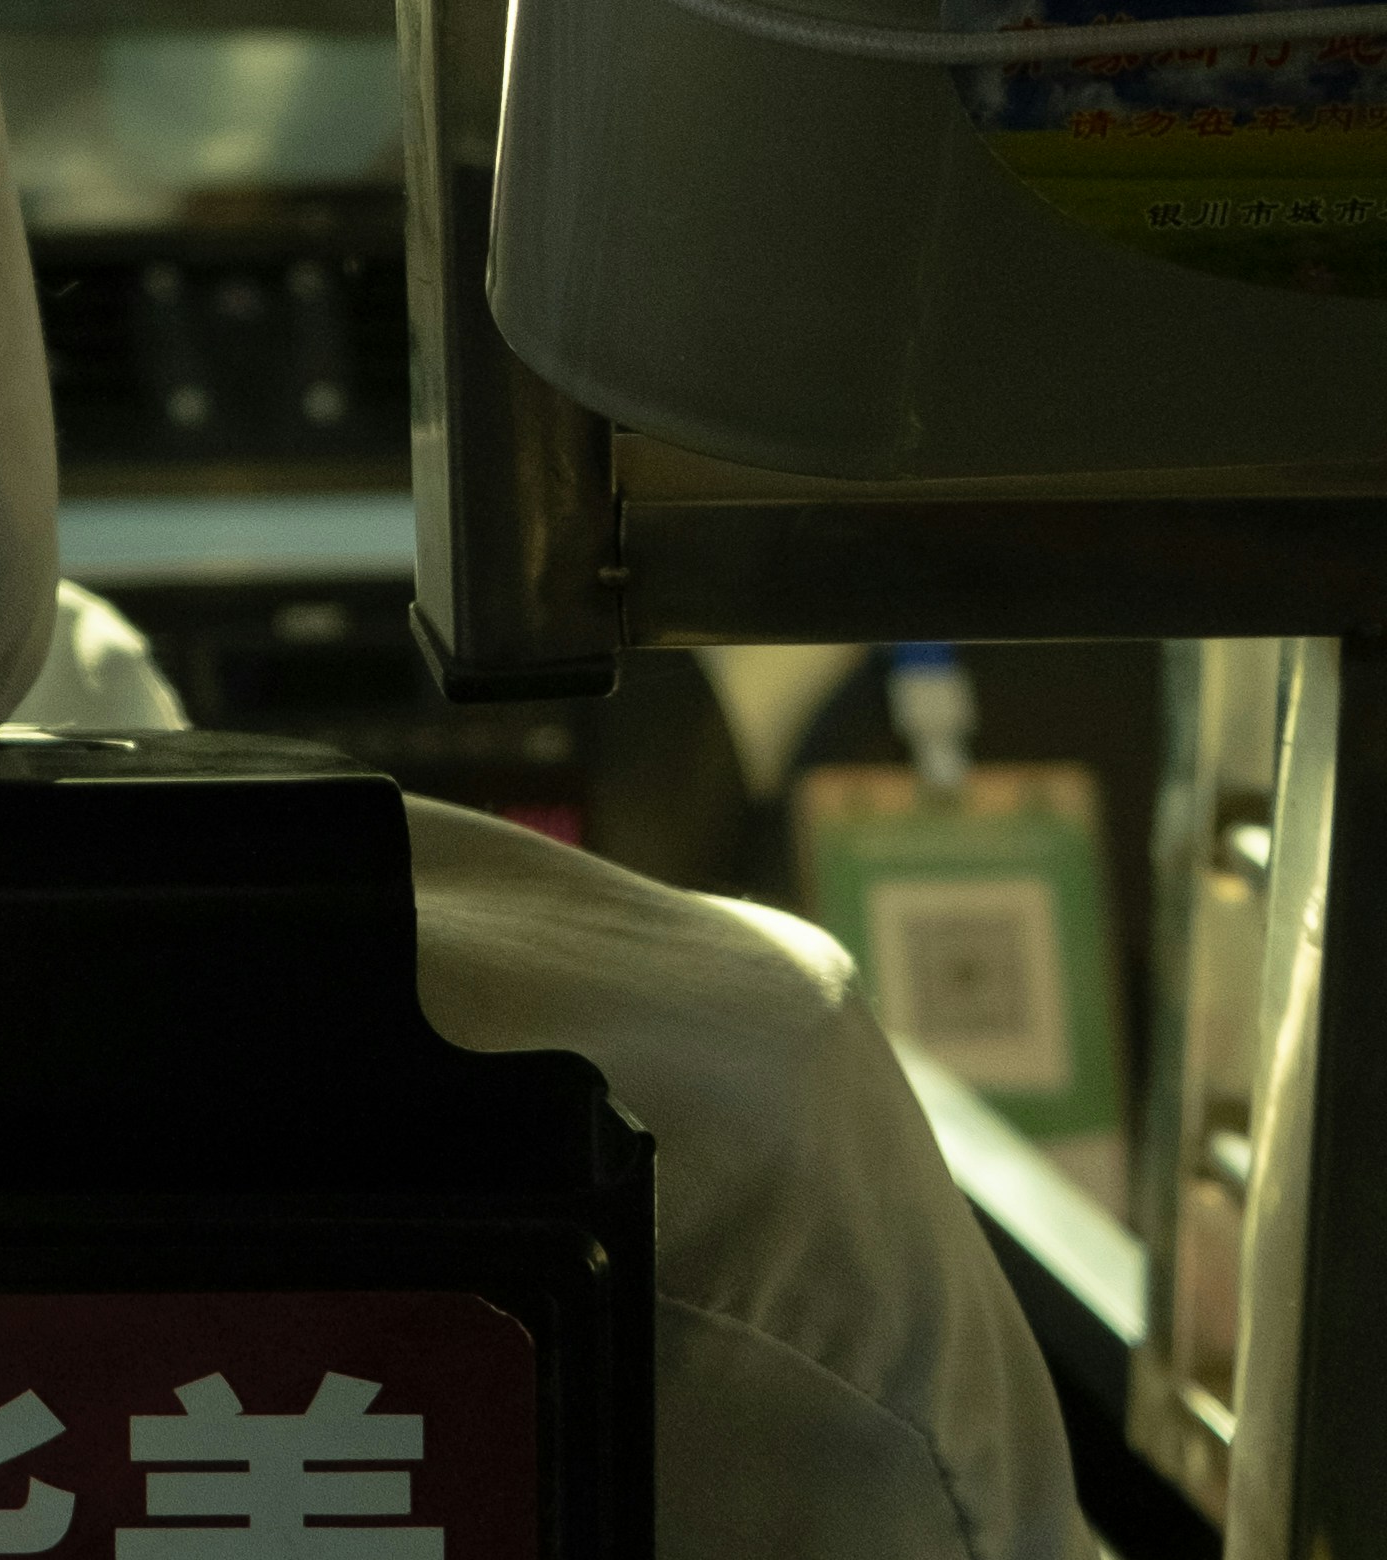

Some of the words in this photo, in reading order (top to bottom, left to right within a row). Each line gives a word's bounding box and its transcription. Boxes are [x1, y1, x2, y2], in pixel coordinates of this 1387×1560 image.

[1147, 196, 1387, 229] 银川市城市
